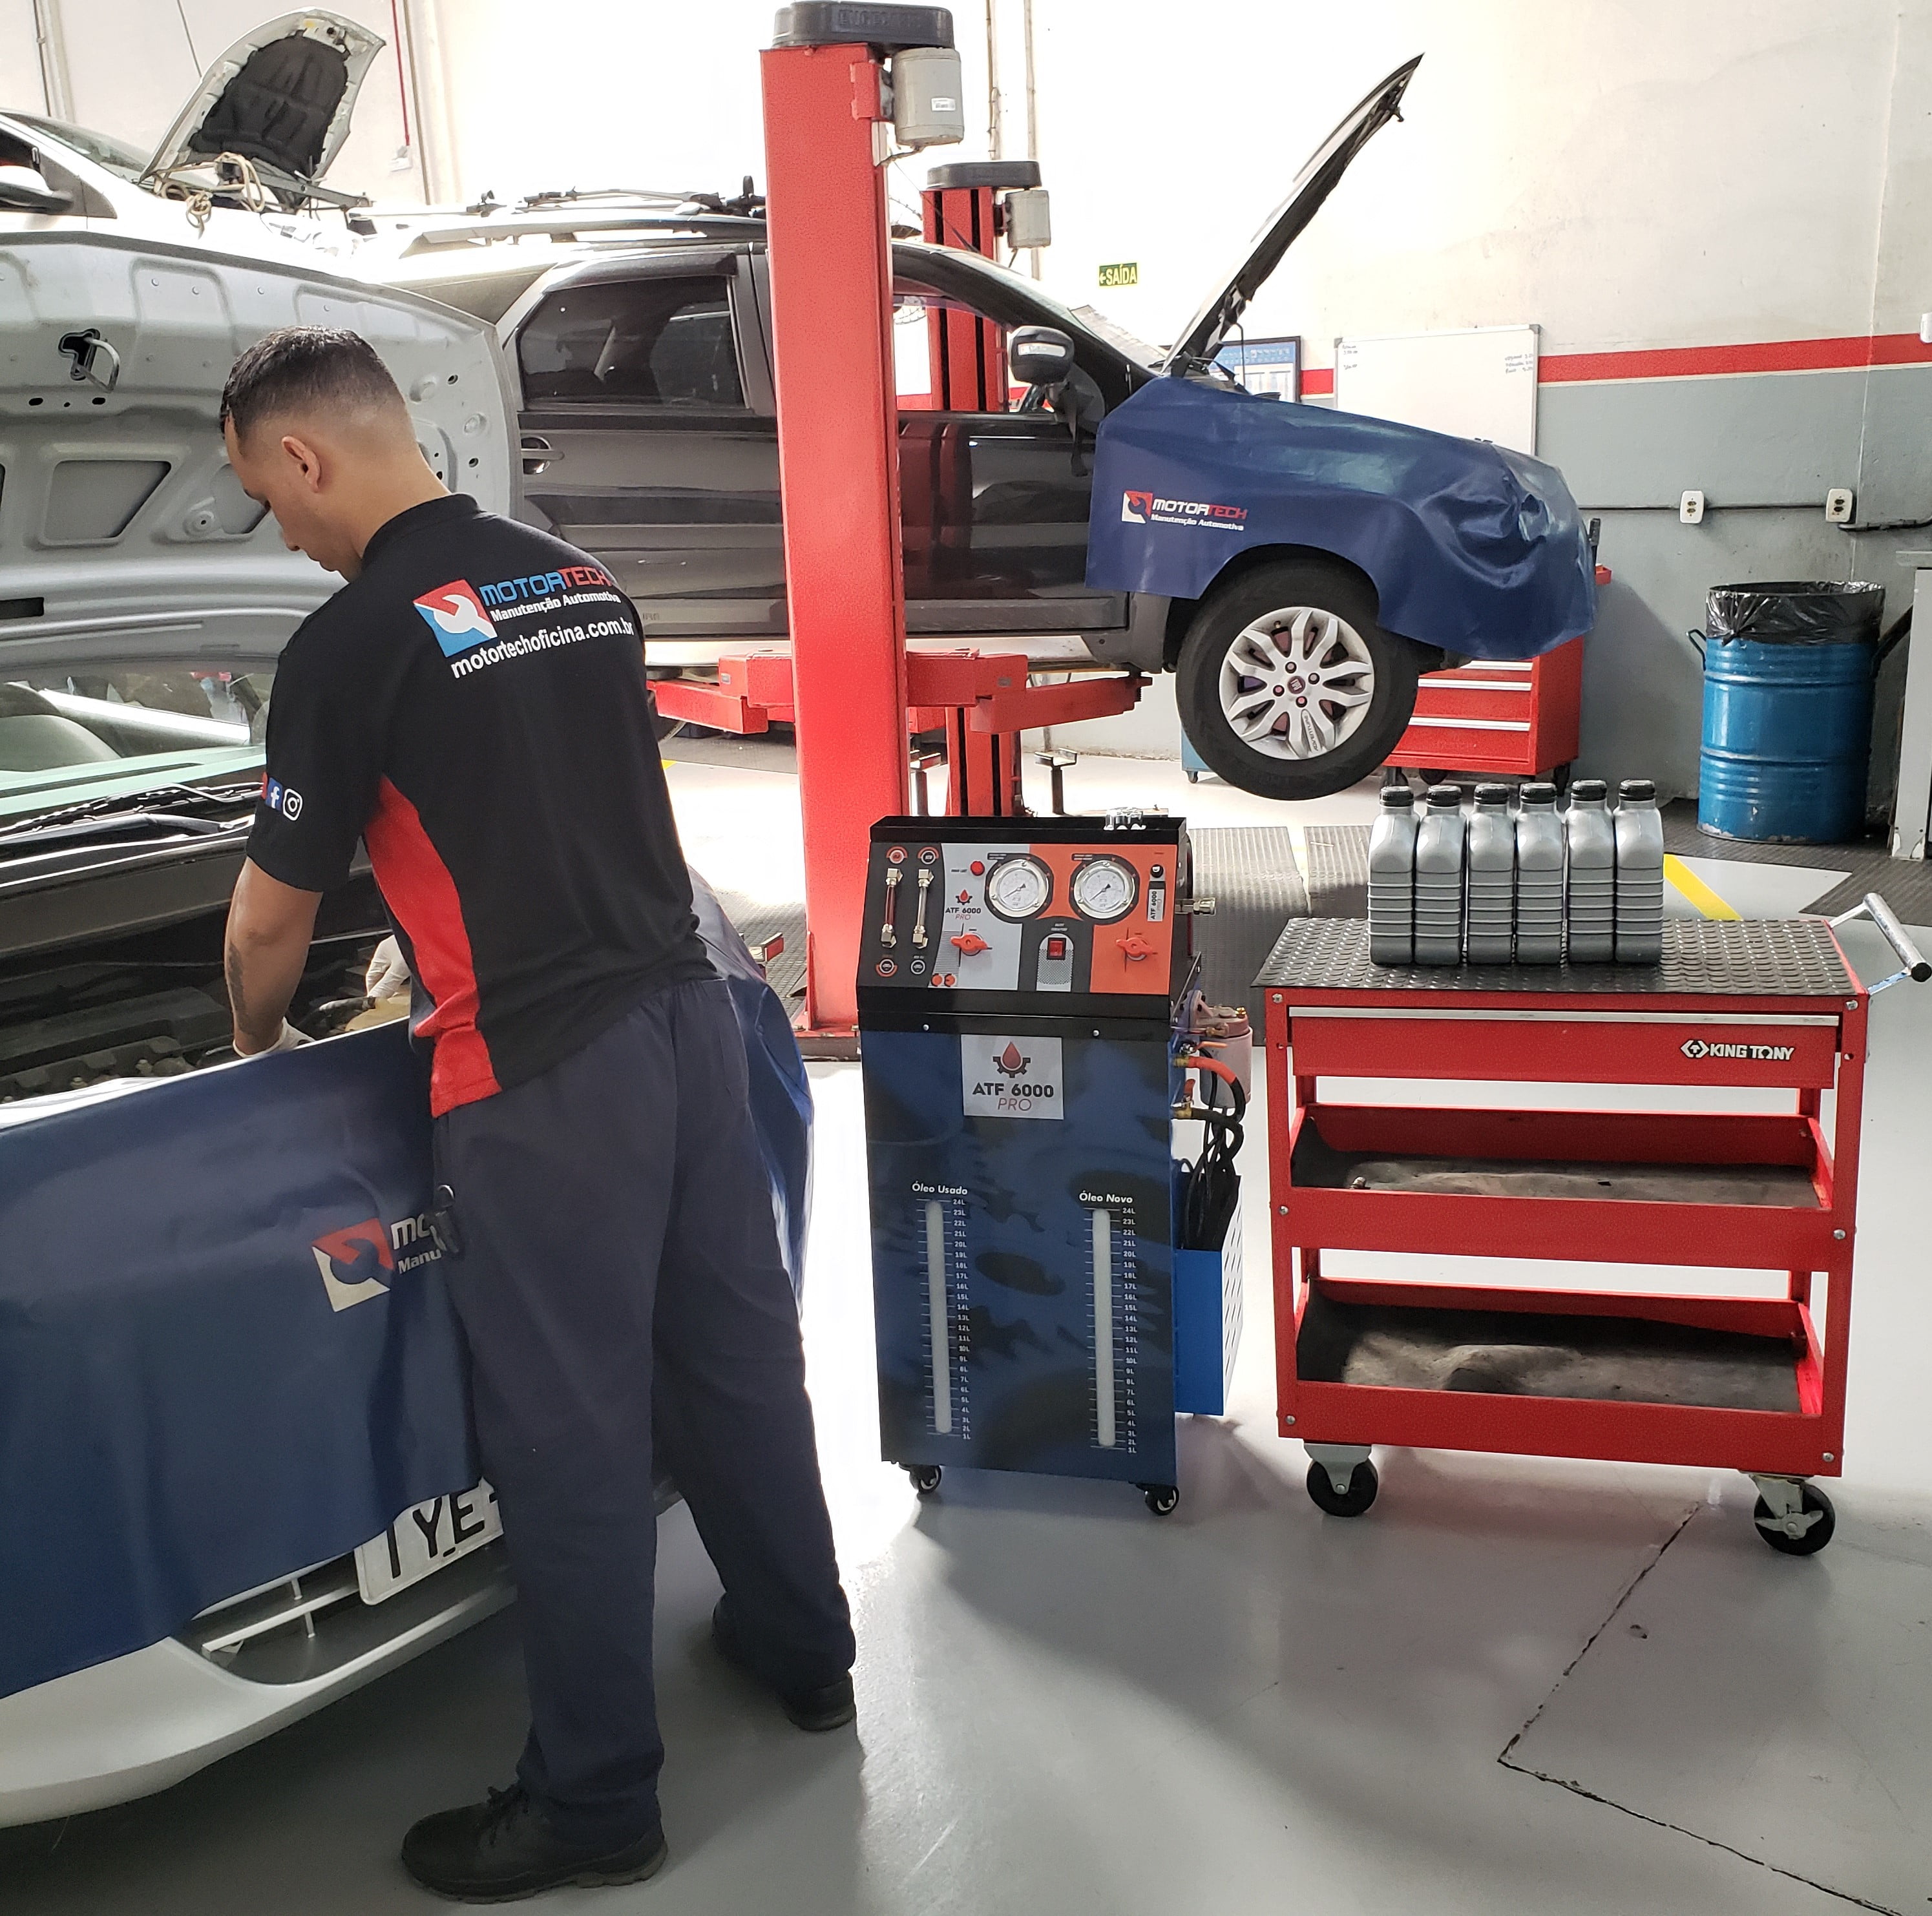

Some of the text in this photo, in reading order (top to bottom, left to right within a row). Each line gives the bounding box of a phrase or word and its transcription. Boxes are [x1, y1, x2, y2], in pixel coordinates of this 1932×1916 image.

[1106, 264, 1137, 286] SAÍDA
[1152, 499, 1248, 520] MOTORTECH
[1151, 514, 1244, 531] Manutenção Automotiva
[480, 567, 611, 606] MOTORTECH
[490, 598, 561, 621] Manutenção
[451, 618, 635, 678] motortechoficina.com.br
[1710, 1043, 1747, 1058] KING
[972, 1082, 1055, 1098] ATF 6000
[997, 1097, 1033, 1111] PRO
[912, 1182, 969, 1195] Óleo Usado
[1079, 1190, 1133, 1203] Óleo Novo
